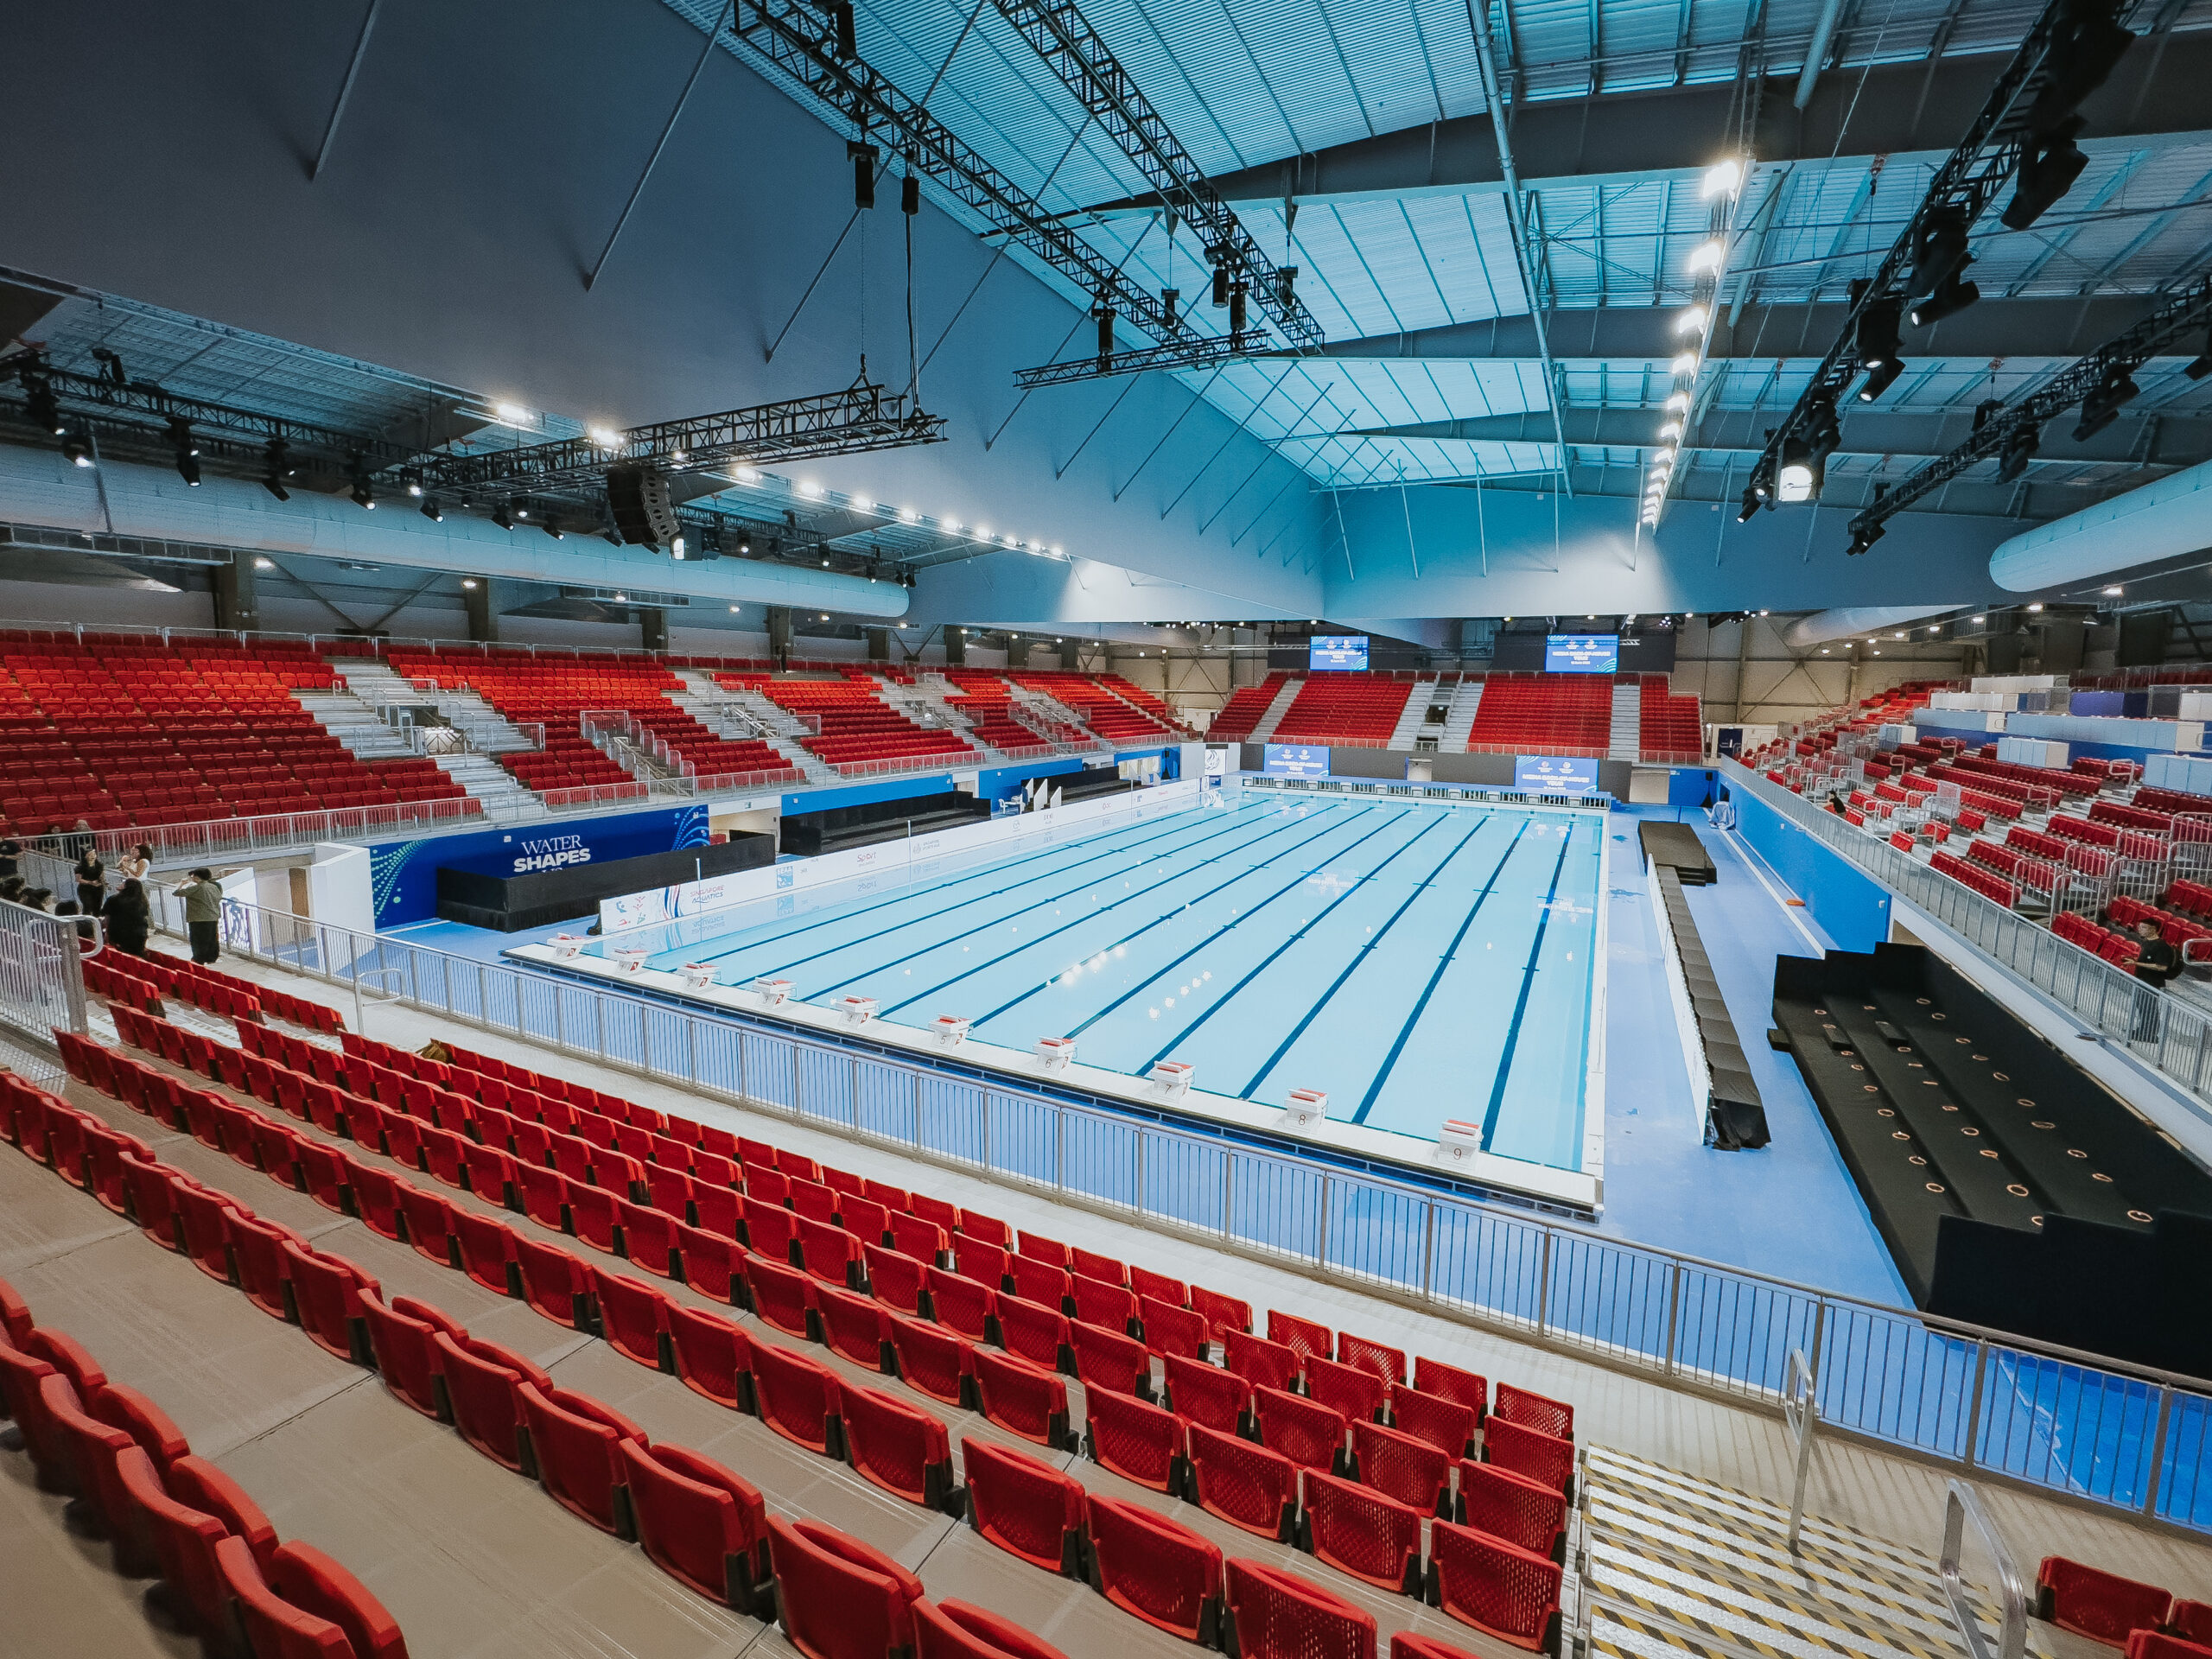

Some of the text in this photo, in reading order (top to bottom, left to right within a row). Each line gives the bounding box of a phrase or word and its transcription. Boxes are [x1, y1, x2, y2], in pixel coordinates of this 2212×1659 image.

[521, 835, 582, 855] WATER
[513, 848, 592, 873] SHAPES
[690, 885, 725, 897] SINGAPORE
[691, 892, 723, 904] AQUATICS
[939, 1035, 947, 1045] 5
[1046, 1058, 1052, 1068] 6
[1166, 1084, 1173, 1094] 7
[1299, 1115, 1306, 1126] 8
[1453, 1147, 1462, 1160] 9
